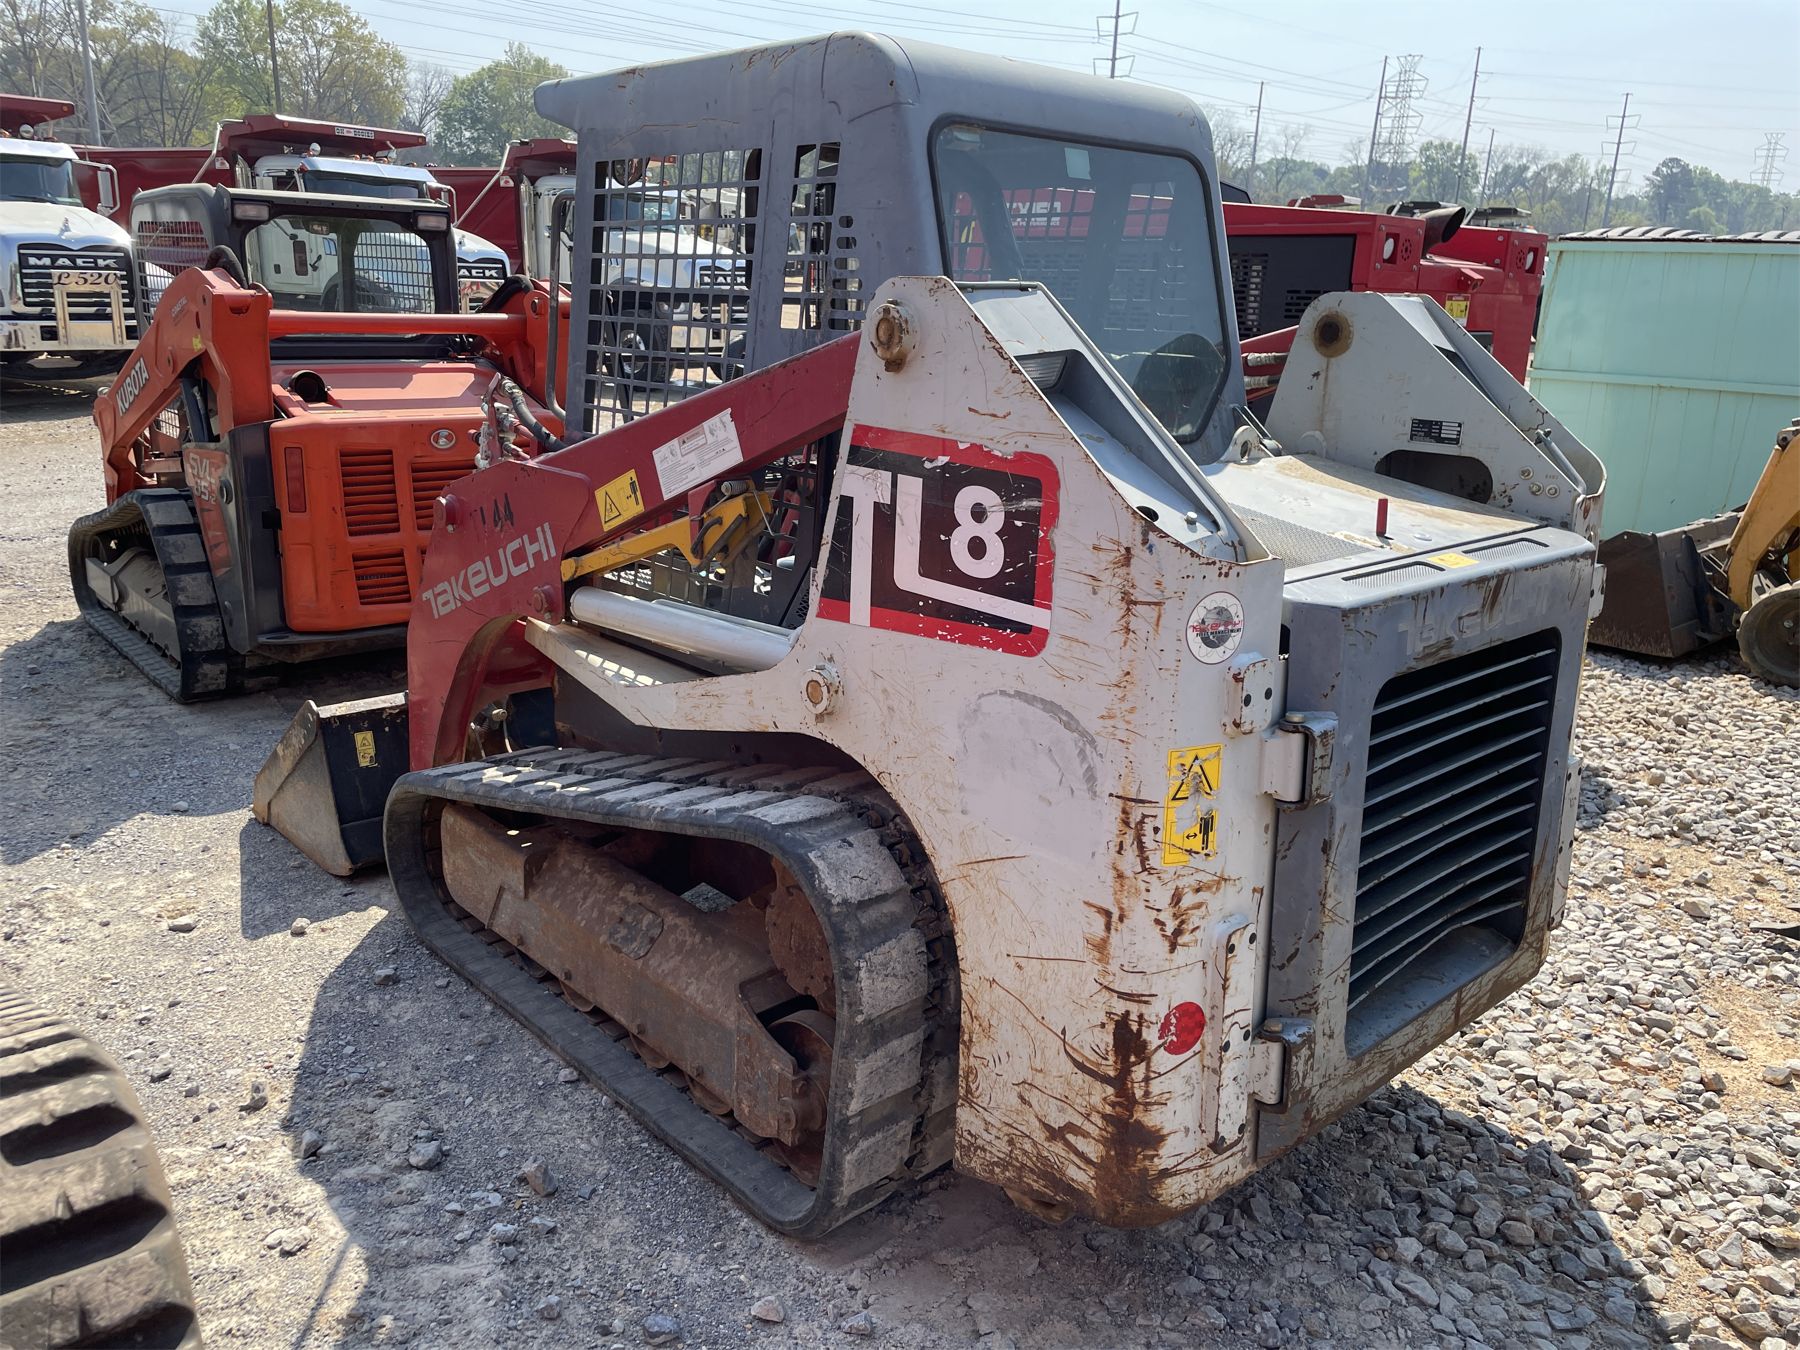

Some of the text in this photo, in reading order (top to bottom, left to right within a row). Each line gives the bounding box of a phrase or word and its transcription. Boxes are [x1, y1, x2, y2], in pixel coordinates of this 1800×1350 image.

[28, 257, 118, 268] MACK
[458, 269, 498, 277] ACK
[116, 357, 149, 416] KUBOTA
[841, 463, 1052, 631] TL8
